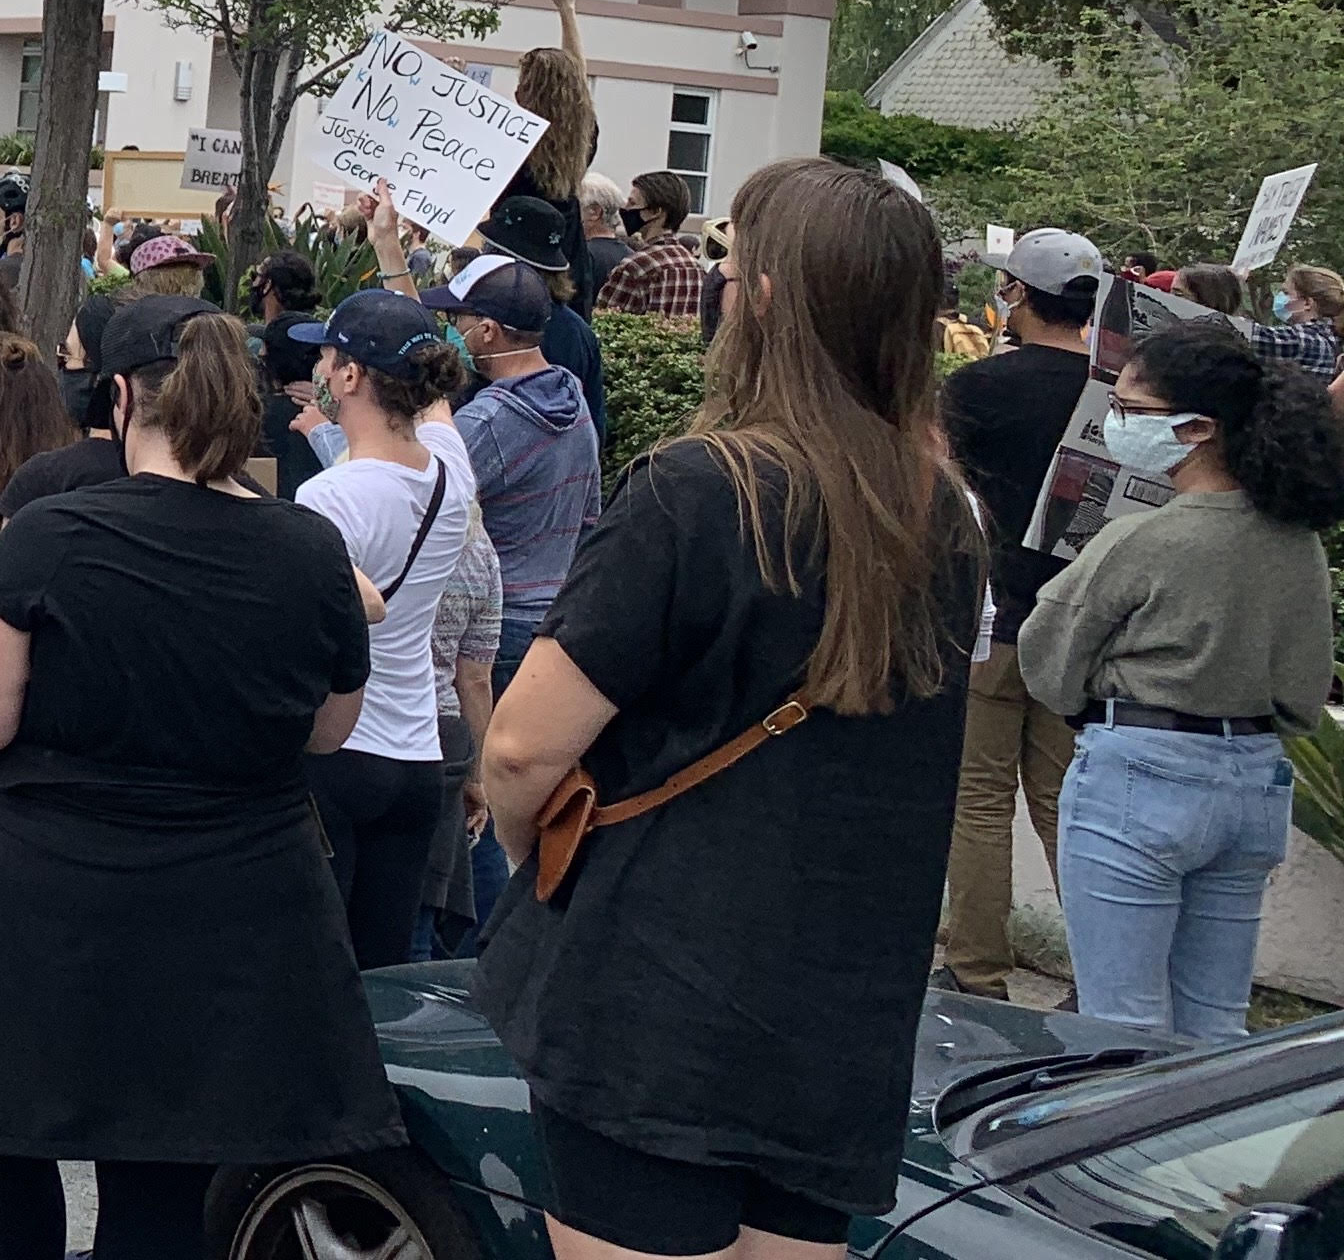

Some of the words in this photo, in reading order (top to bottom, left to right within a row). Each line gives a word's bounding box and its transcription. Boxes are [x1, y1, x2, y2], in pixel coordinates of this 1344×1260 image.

[431, 73, 540, 145] JUSTICE
[212, 138, 242, 154] CAN
[322, 115, 385, 159] Justice
[395, 152, 438, 180] for
[408, 108, 496, 181] Peace
[191, 168, 241, 187] BREAT
[401, 189, 456, 225] Floyd
